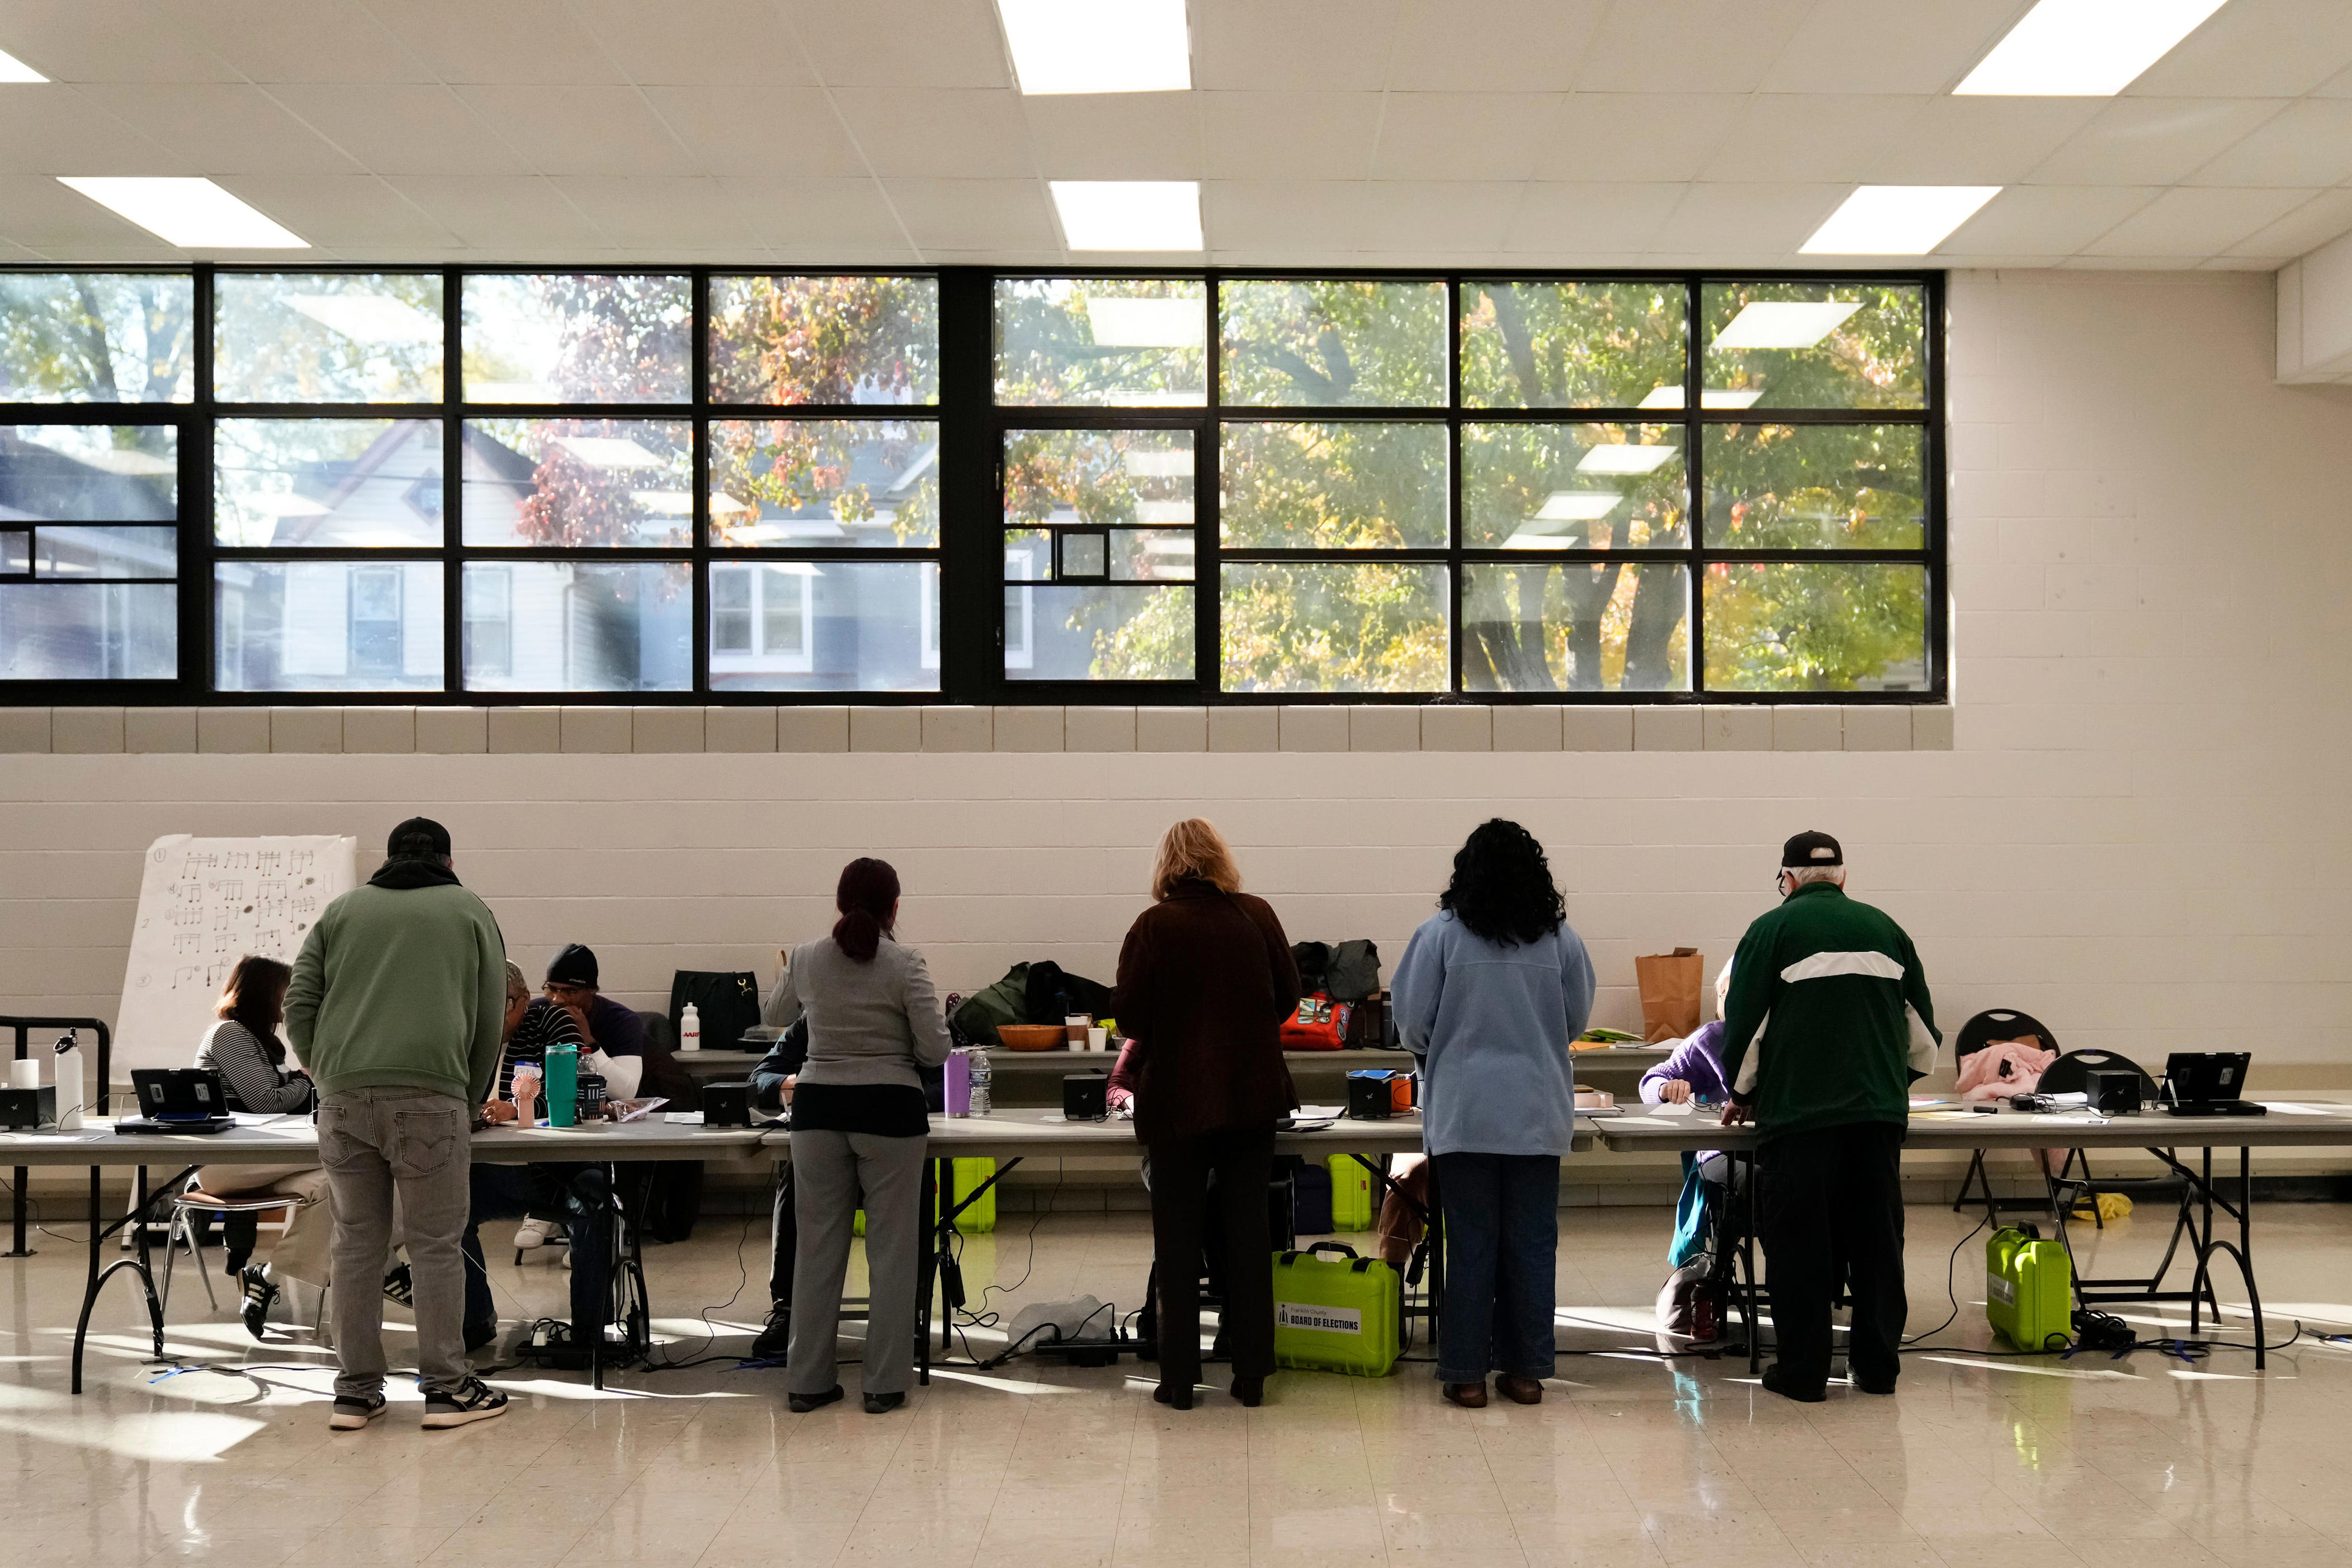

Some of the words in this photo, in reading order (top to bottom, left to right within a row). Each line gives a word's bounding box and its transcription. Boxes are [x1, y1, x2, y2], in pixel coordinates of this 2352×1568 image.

[141, 918, 150, 928] 2
[1291, 1315, 1312, 1325] BOARD
[1314, 1317, 1321, 1326] OF
[1323, 1318, 1358, 1330] ELECTIONS
